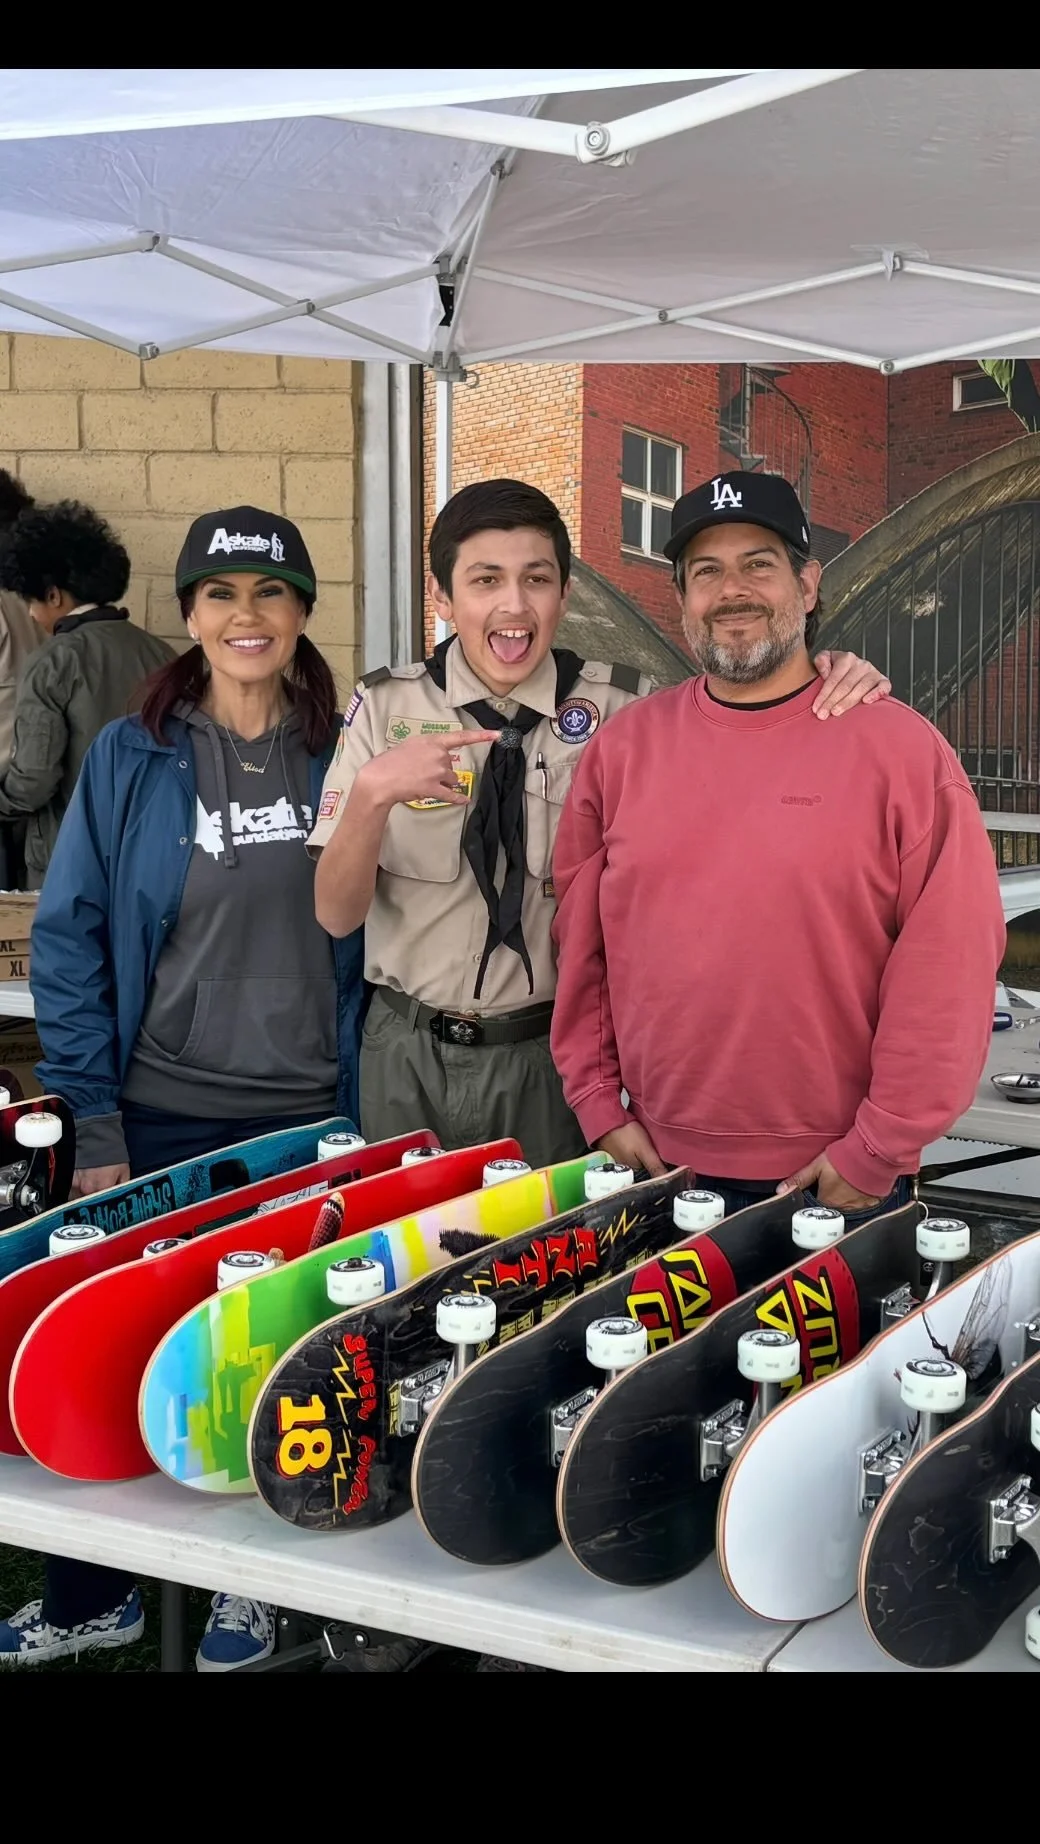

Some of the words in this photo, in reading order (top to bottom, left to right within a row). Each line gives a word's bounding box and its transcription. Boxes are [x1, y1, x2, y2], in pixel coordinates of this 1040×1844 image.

[710, 478, 743, 511] LA
[207, 528, 271, 555] Askate
[10, 960, 27, 977] XL
[342, 1333, 376, 1421] SUPER
[276, 1394, 333, 1481] 18
[342, 1434, 376, 1516] POWER
